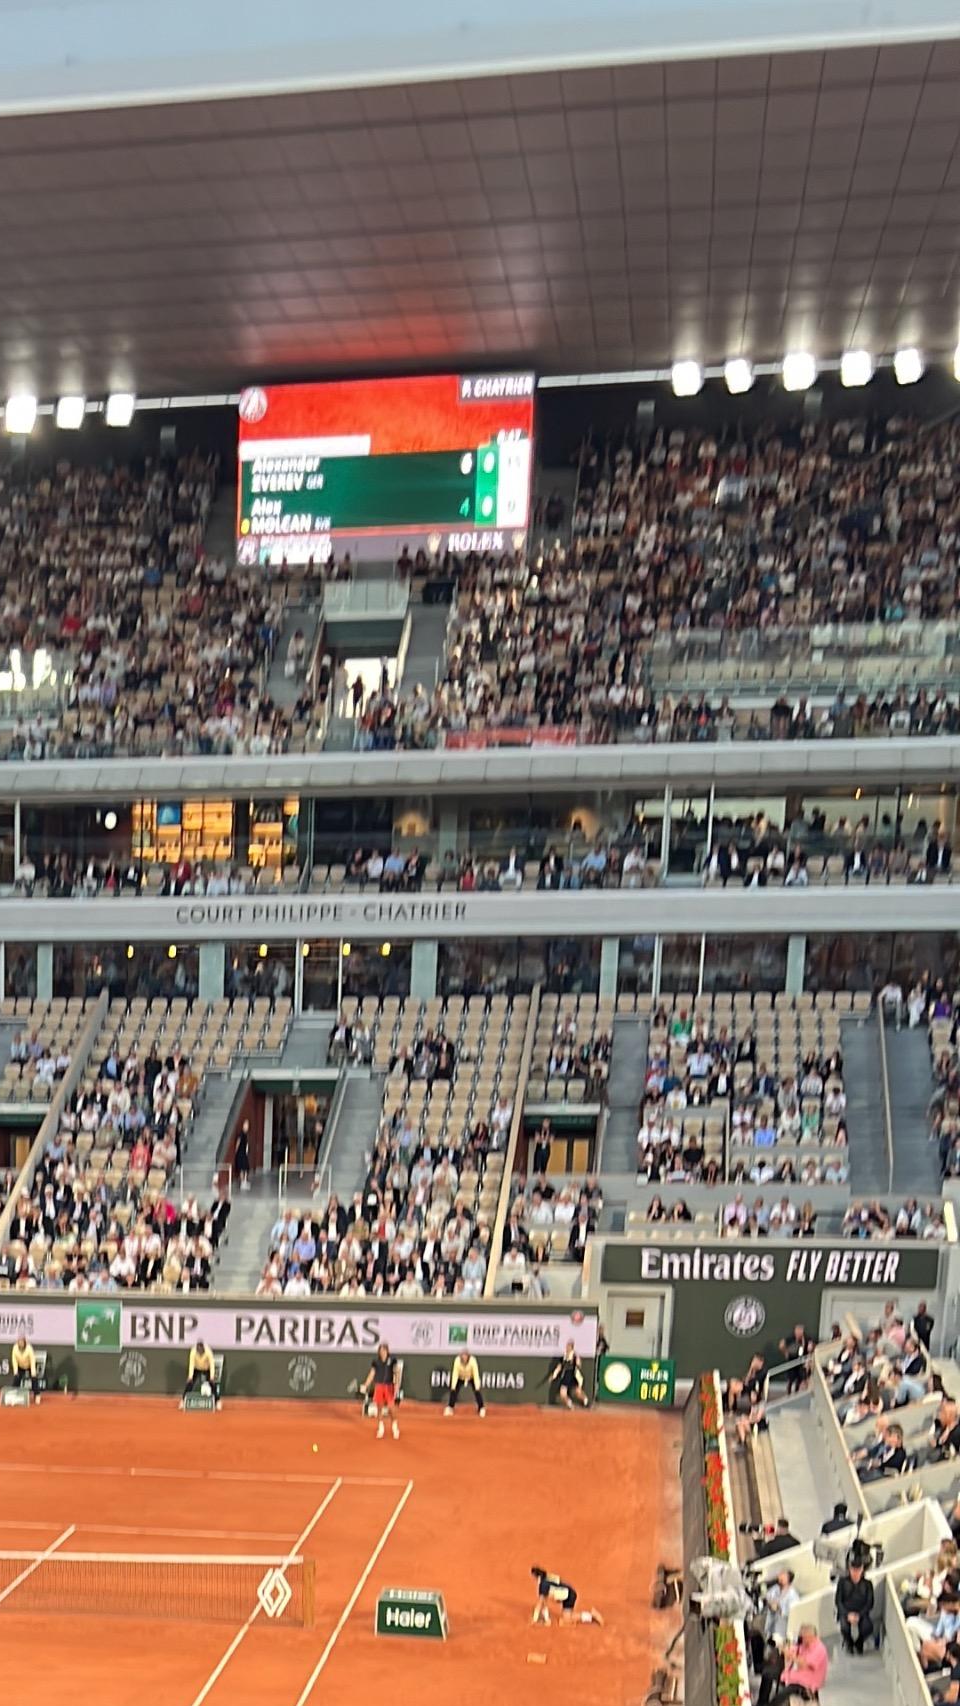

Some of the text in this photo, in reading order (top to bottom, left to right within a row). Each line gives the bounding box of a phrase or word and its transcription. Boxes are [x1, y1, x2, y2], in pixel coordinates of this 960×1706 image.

[175, 901, 468, 925] COURT PHILIPPE CHATRIER
[640, 1247, 900, 1284] Emirates FLY BETTER
[129, 1313, 381, 1346] BNP PARIBAS
[431, 1370, 451, 1388] BN
[386, 1606, 432, 1629] Haier
